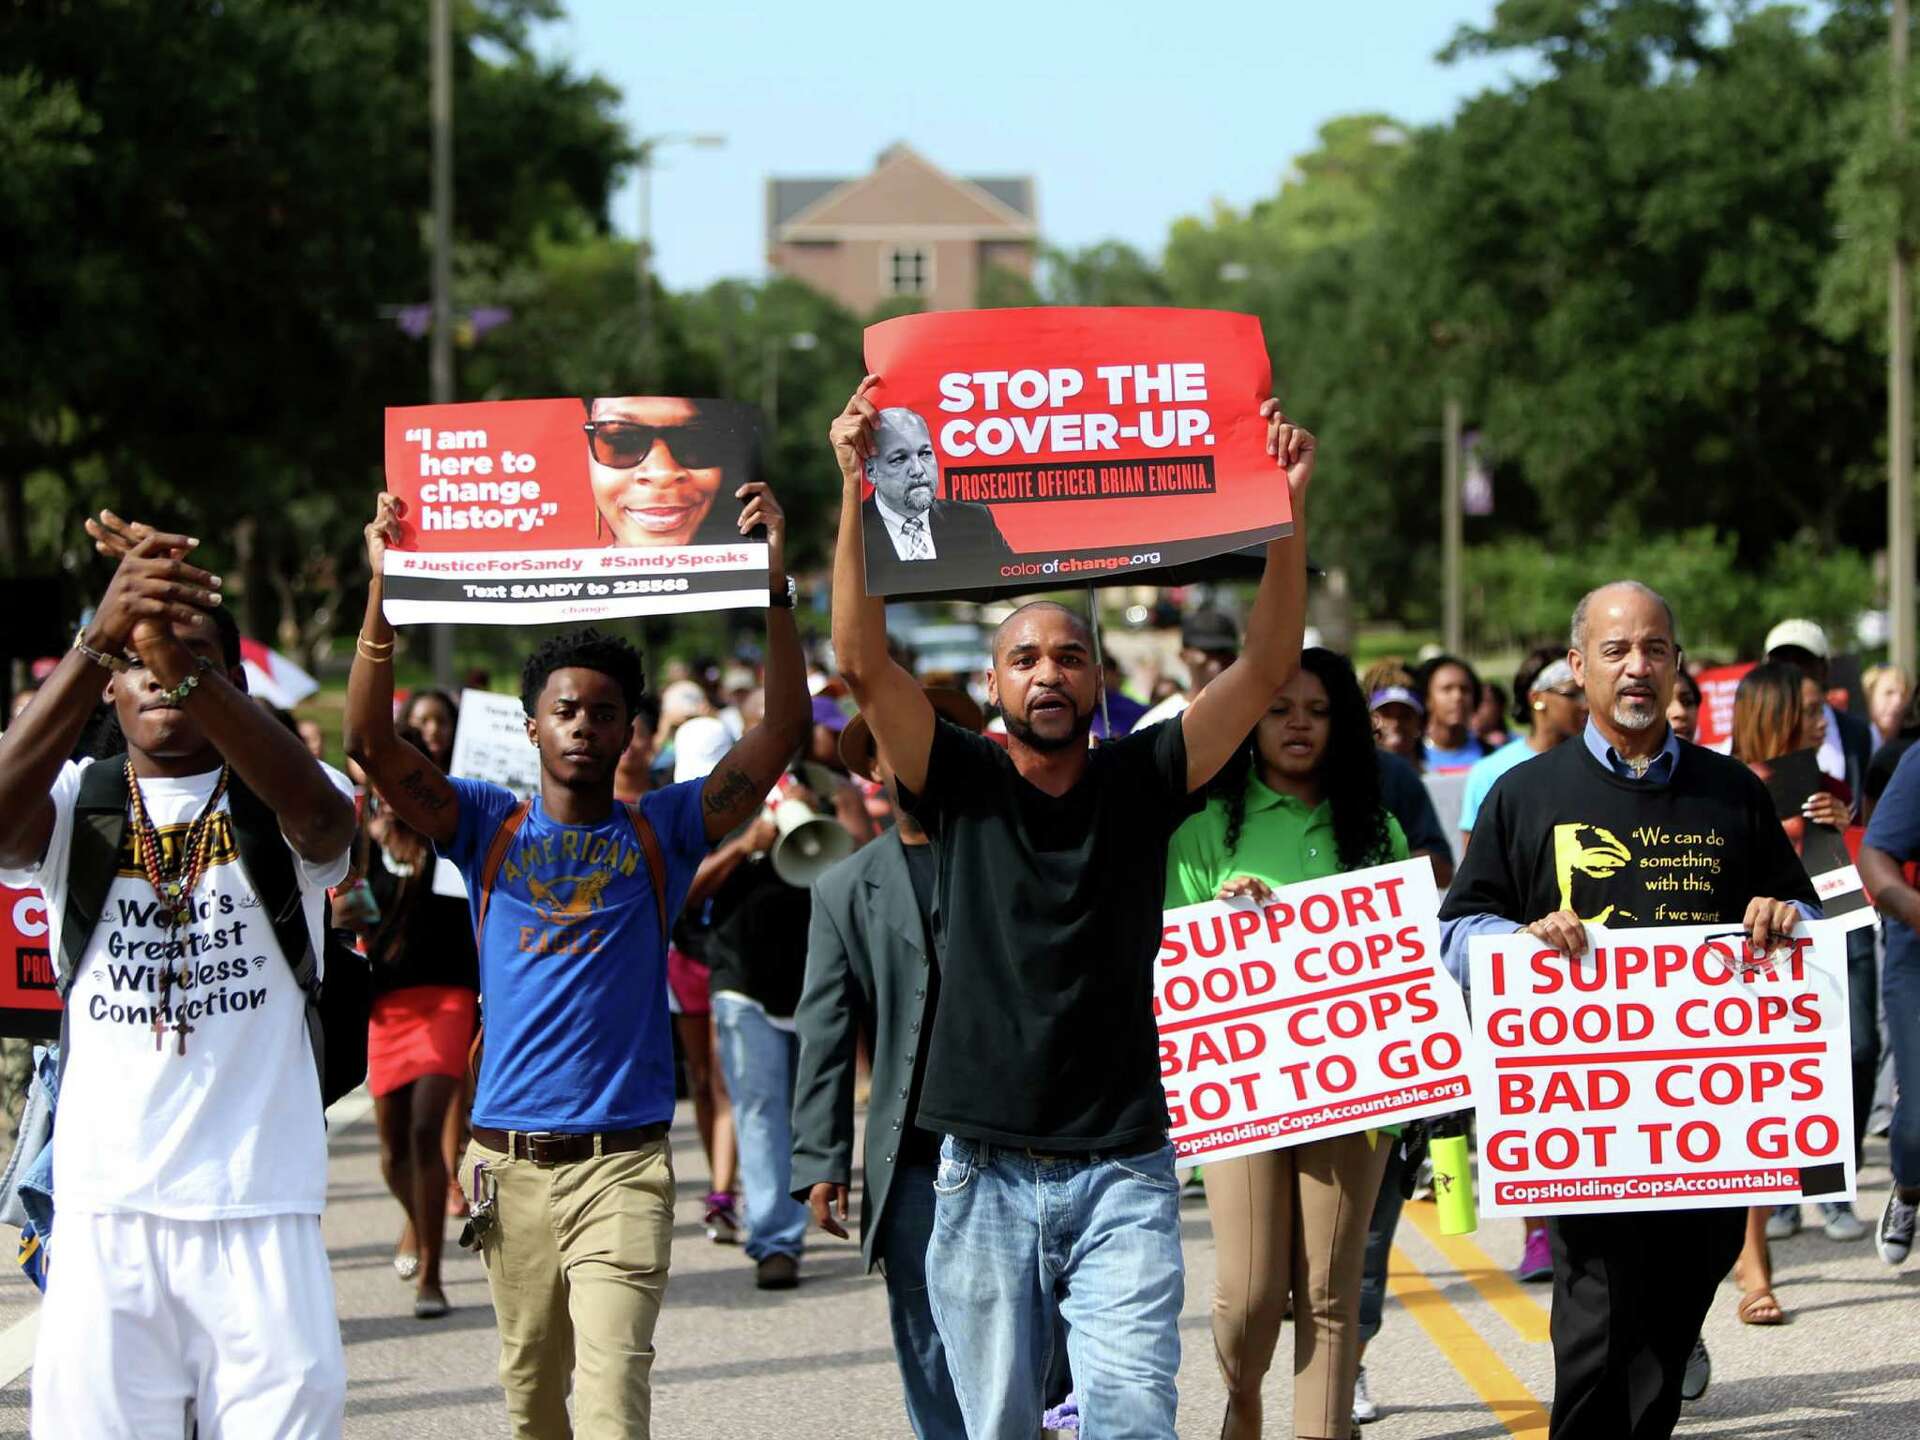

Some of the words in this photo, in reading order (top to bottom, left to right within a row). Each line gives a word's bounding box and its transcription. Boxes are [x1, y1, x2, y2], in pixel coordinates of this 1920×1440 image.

[938, 367, 1083, 413] STOP
[1097, 362, 1208, 405] THE
[436, 428, 488, 448] am
[939, 408, 1215, 458] COVER-UP.
[420, 453, 493, 477] here
[501, 451, 536, 473] to
[951, 471, 1034, 501] PROSECUTE
[1037, 468, 1095, 497] OFFICER
[1100, 466, 1142, 493] BRIAN
[1148, 463, 1212, 490] ENCINIA.
[420, 479, 541, 504] change
[403, 557, 584, 573] #JusticeForSandy
[600, 552, 749, 568] #SandySpeaks
[1000, 549, 1161, 578] colorofchange.org
[463, 584, 508, 598] Text
[510, 583, 584, 598] SANDY
[587, 582, 609, 595] to
[612, 578, 689, 594] 225568
[503, 830, 641, 882] AMERICAN
[1674, 833, 1702, 845] can
[1706, 829, 1725, 846] do
[1639, 851, 1721, 873] something
[1645, 874, 1678, 891] with
[1683, 873, 1715, 894] this,
[118, 889, 234, 927] Wold's
[1160, 877, 1405, 967] SUPPORT
[1655, 903, 1667, 921] if
[1669, 910, 1688, 921] we
[1691, 910, 1720, 922] want
[108, 921, 248, 960] Greatest
[1152, 960, 1276, 1017] OOD
[1294, 926, 1425, 983] COPS
[1491, 953, 1505, 995] I
[1159, 1022, 1267, 1078] BAD
[1287, 982, 1439, 1046] COPS
[1487, 1003, 1654, 1048] GOOD
[1675, 993, 1822, 1038] COPS
[1279, 1055, 1357, 1102] TO
[1378, 1032, 1462, 1079] GO
[1499, 1069, 1631, 1115] BAD
[1655, 1058, 1824, 1107] COPS
[1486, 1126, 1617, 1172] GOT
[1638, 1120, 1721, 1165] TO
[1746, 1115, 1840, 1160] GO
